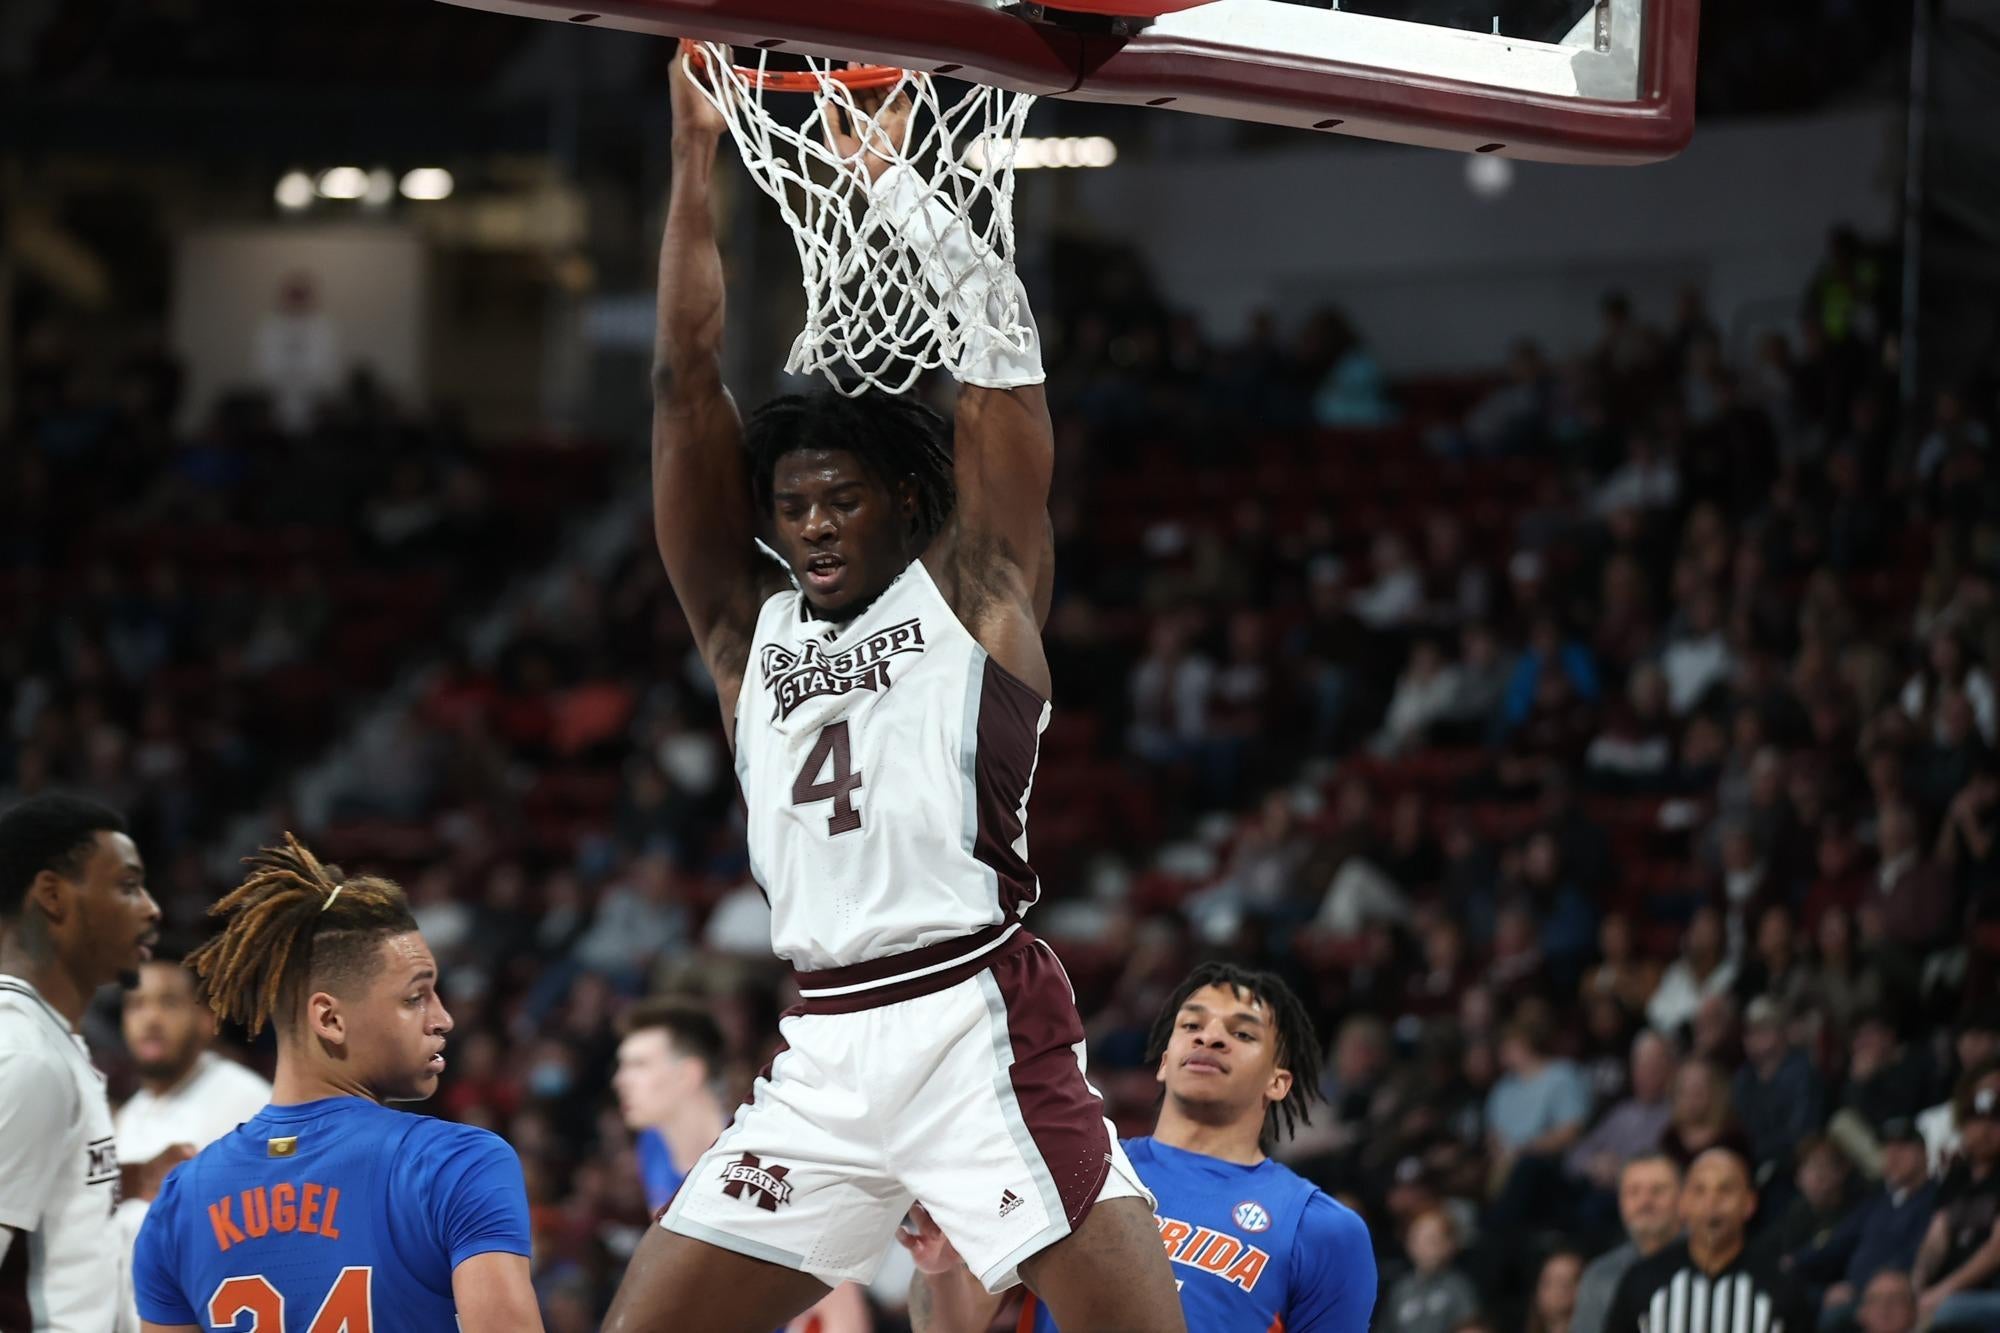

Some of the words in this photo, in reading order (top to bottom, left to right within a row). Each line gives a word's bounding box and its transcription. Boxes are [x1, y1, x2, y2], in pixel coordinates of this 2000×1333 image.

[782, 670, 866, 708] STATE
[792, 720, 863, 836] 4
[734, 1167, 779, 1195] STATE
[208, 1183, 340, 1251] KUGEL
[999, 1197, 1024, 1217] adidas
[1234, 1203, 1268, 1230] SEC
[1153, 1213, 1270, 1293] RIDA
